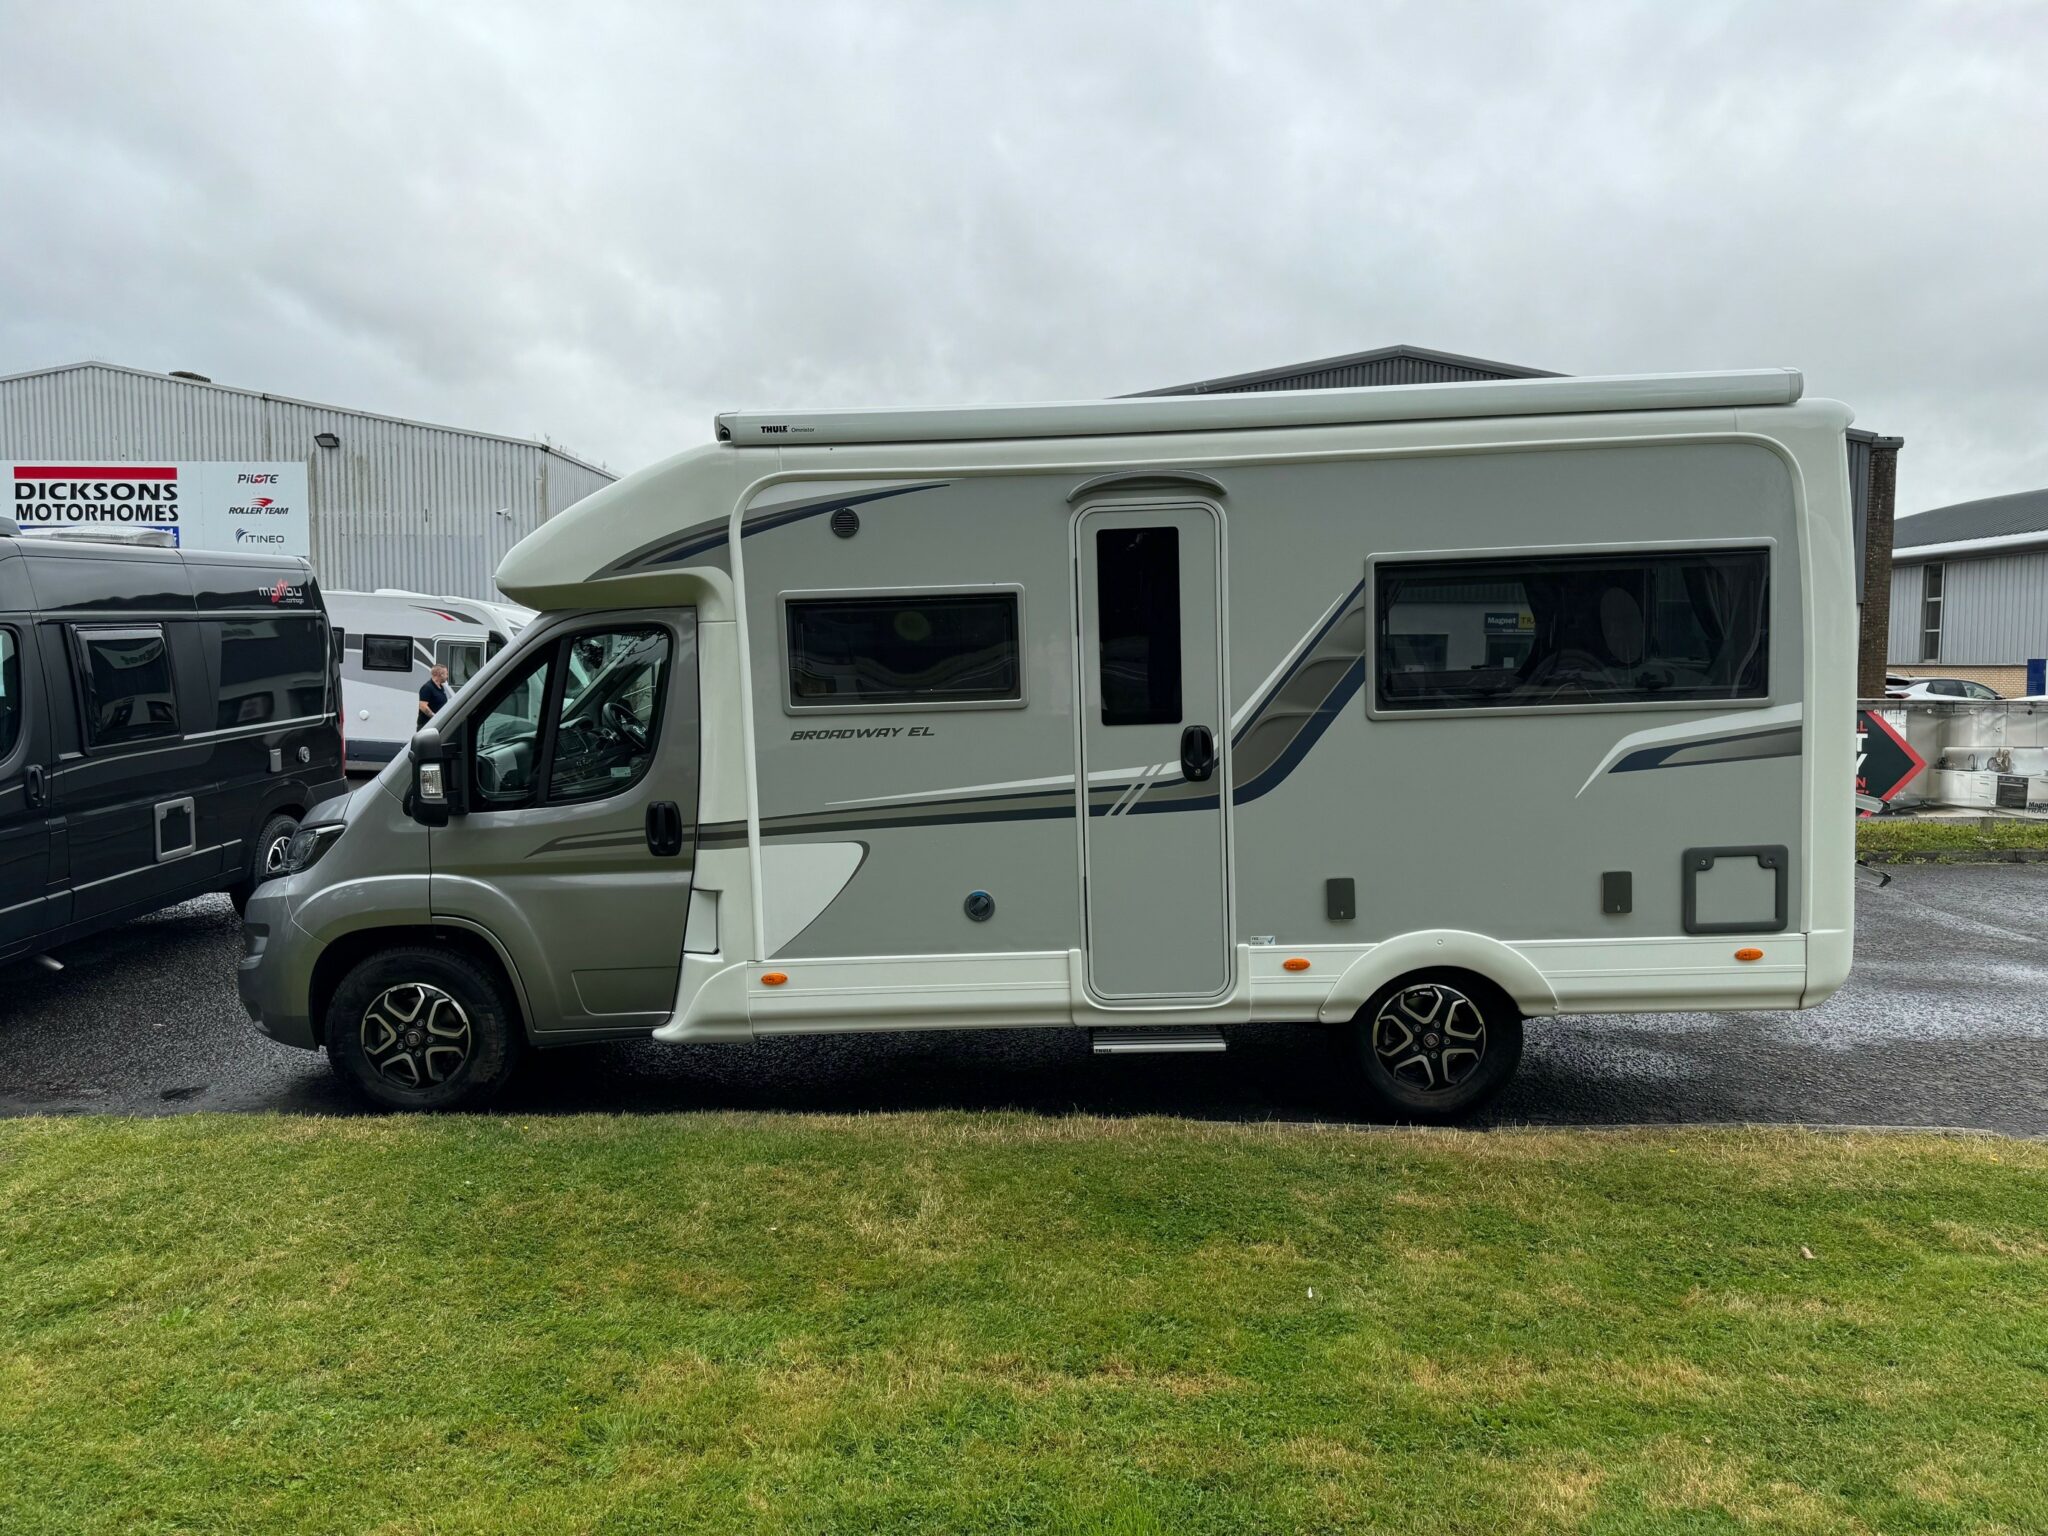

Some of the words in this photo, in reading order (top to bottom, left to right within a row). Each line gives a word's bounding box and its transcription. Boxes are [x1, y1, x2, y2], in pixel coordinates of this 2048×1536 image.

[761, 425, 788, 433] THULE
[15, 483, 178, 501] DICKSONS
[16, 503, 179, 522] MOTORHOMES
[228, 507, 262, 515] ROLLER
[264, 507, 289, 515] TEAM
[245, 535, 285, 543] ITINEO
[258, 584, 303, 597] malibu
[1487, 616, 1516, 625] Magnet
[790, 727, 904, 741] BROADWAY
[908, 726, 935, 737] EL
[2028, 801, 2048, 809] Magn
